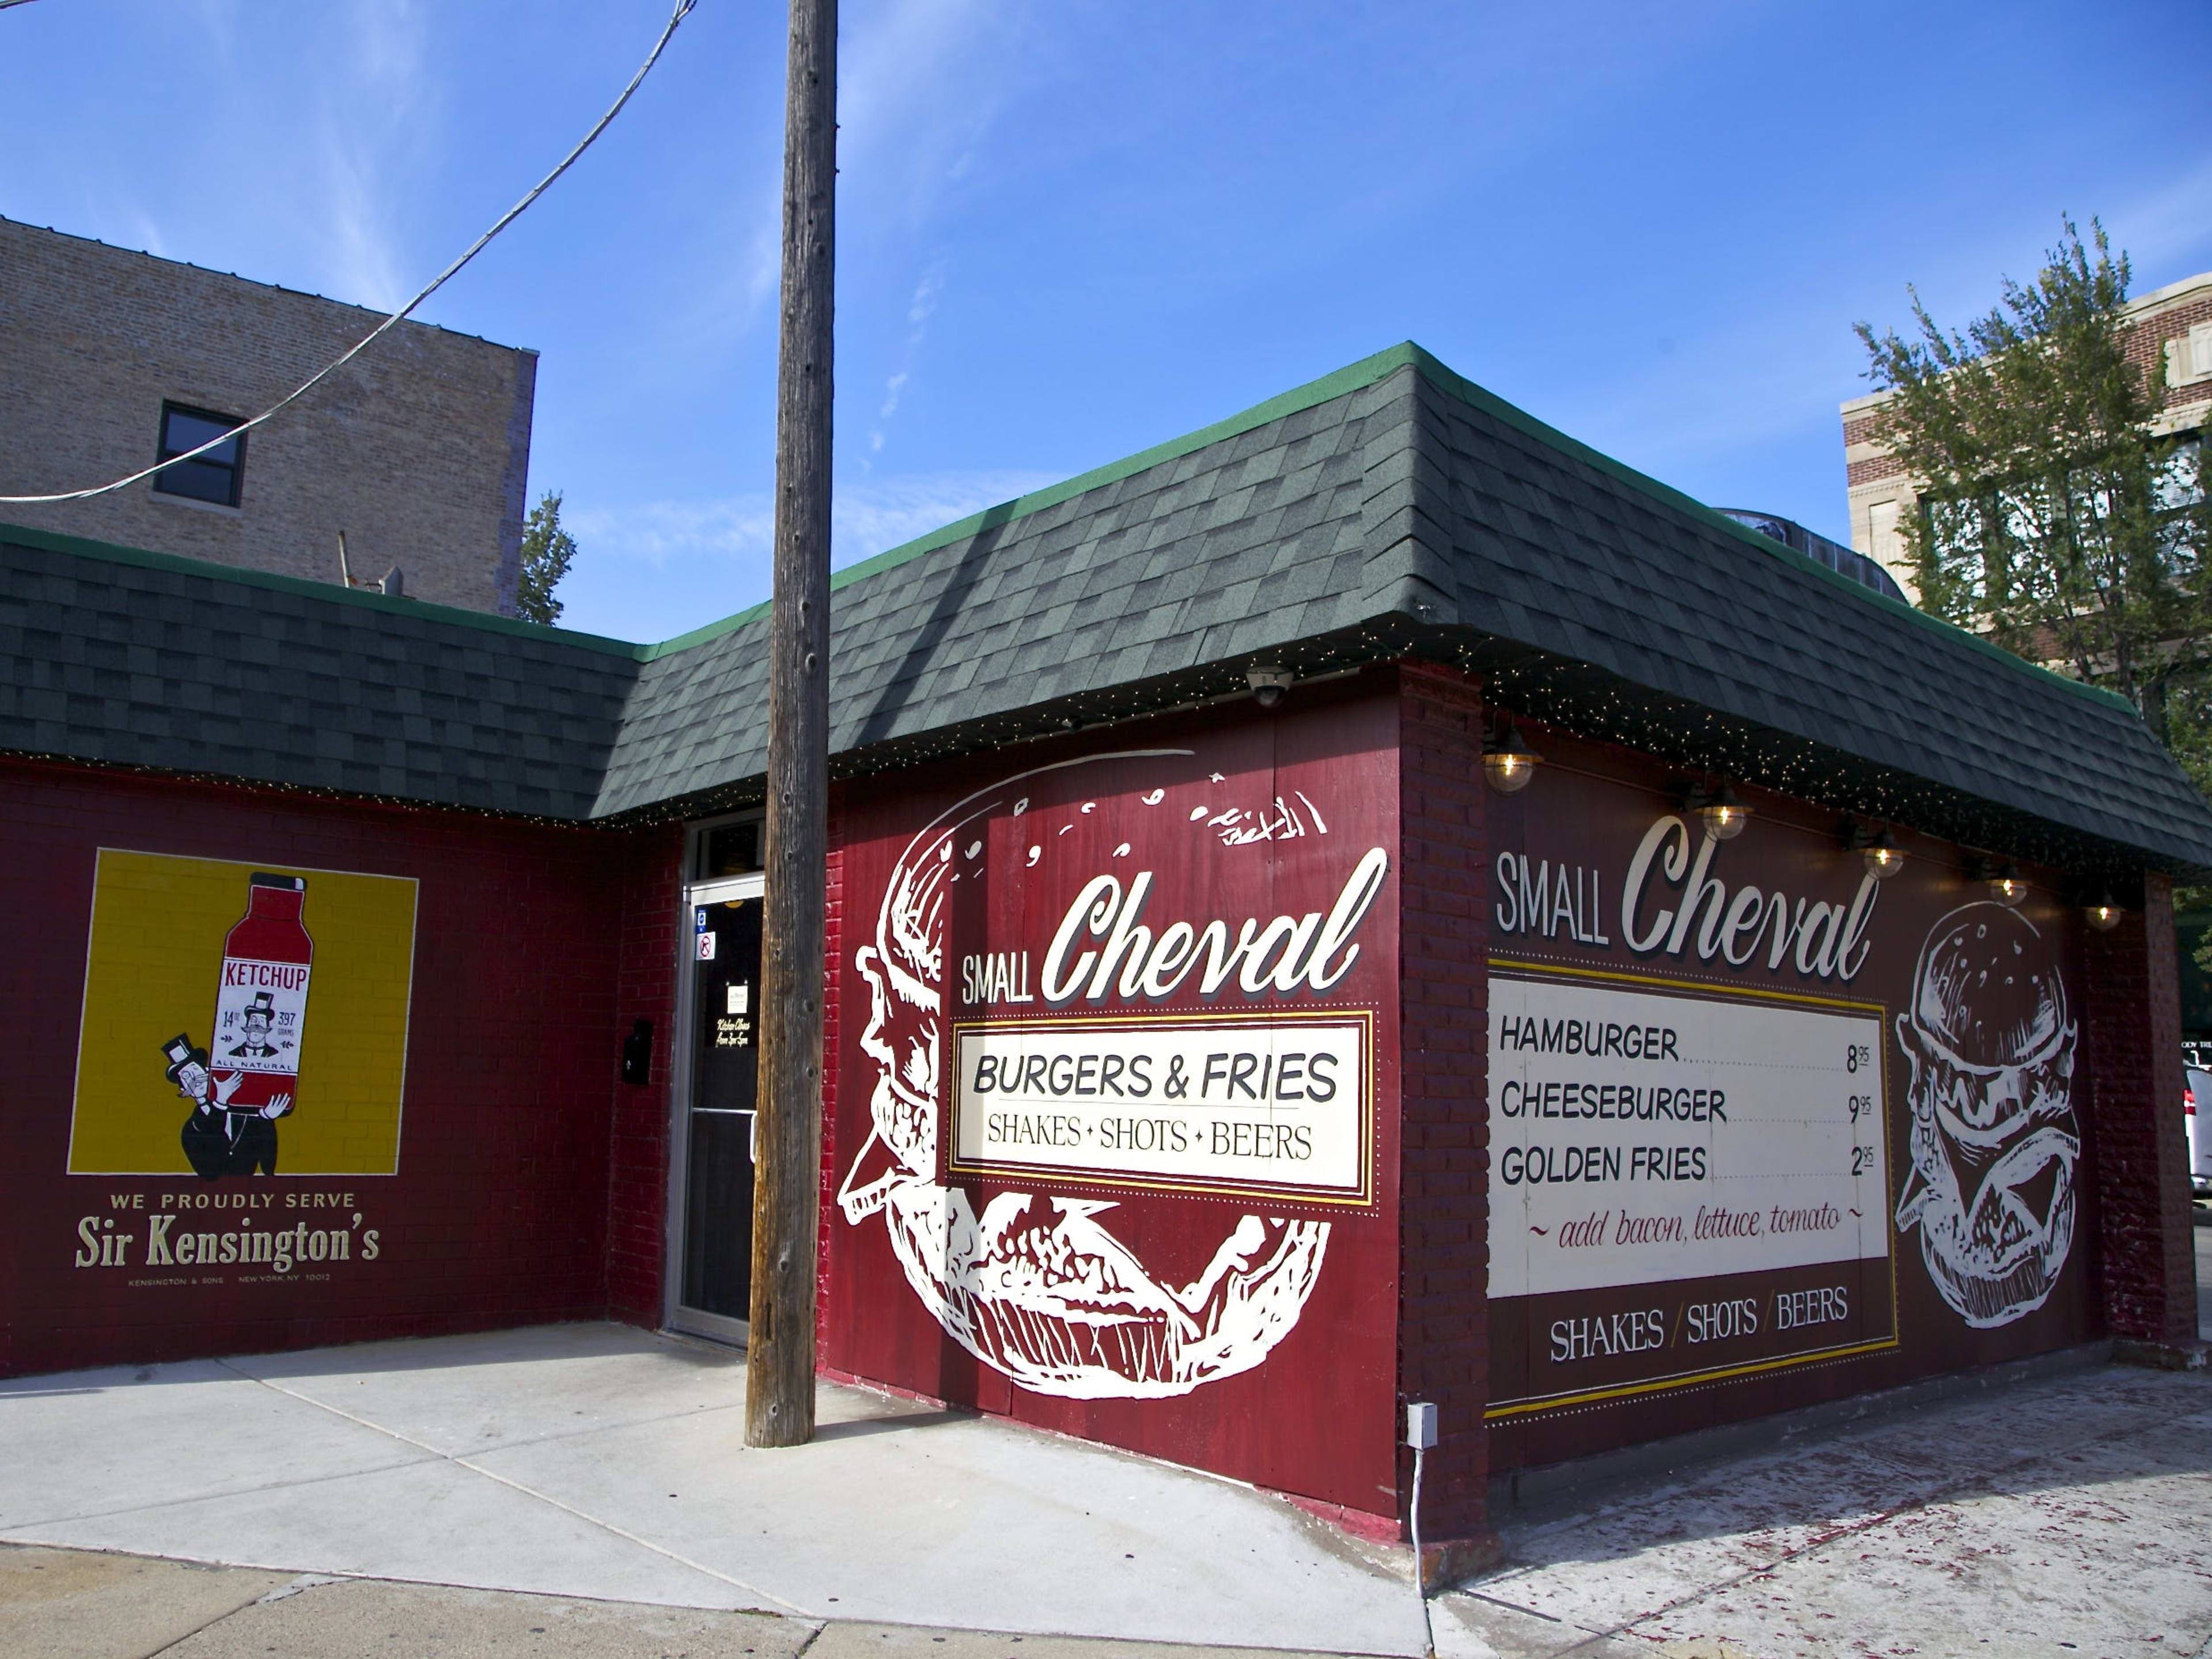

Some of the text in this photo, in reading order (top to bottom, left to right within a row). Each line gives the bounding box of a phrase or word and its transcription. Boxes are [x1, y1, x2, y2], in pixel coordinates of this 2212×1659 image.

[1497, 816, 1880, 980] SMALL Cheval
[963, 847, 1387, 1005] SMALL Cheval
[225, 963, 307, 991] KETCHUP
[223, 1010, 234, 1028] 14
[278, 1012, 296, 1026] 397
[1500, 1016, 1679, 1061] HAMBURGER
[241, 1062, 293, 1070] NATURAL
[974, 1053, 1338, 1102] BURGERS & FRIES
[1501, 1081, 1728, 1123] CHEESEBURGER
[988, 1114, 1313, 1160] SHAKES SHOTS BEERS
[1501, 1146, 1621, 1185] GOLDEN
[1630, 1146, 1706, 1181] FRIES
[111, 1194, 355, 1209] WE PROUDLY SERVE
[75, 1213, 380, 1273] Sir Kensington's
[1559, 1202, 1841, 1248] add bacon, lettuce, tomato
[1551, 1286, 1848, 1363] SHAKES SHOTS BEERS
